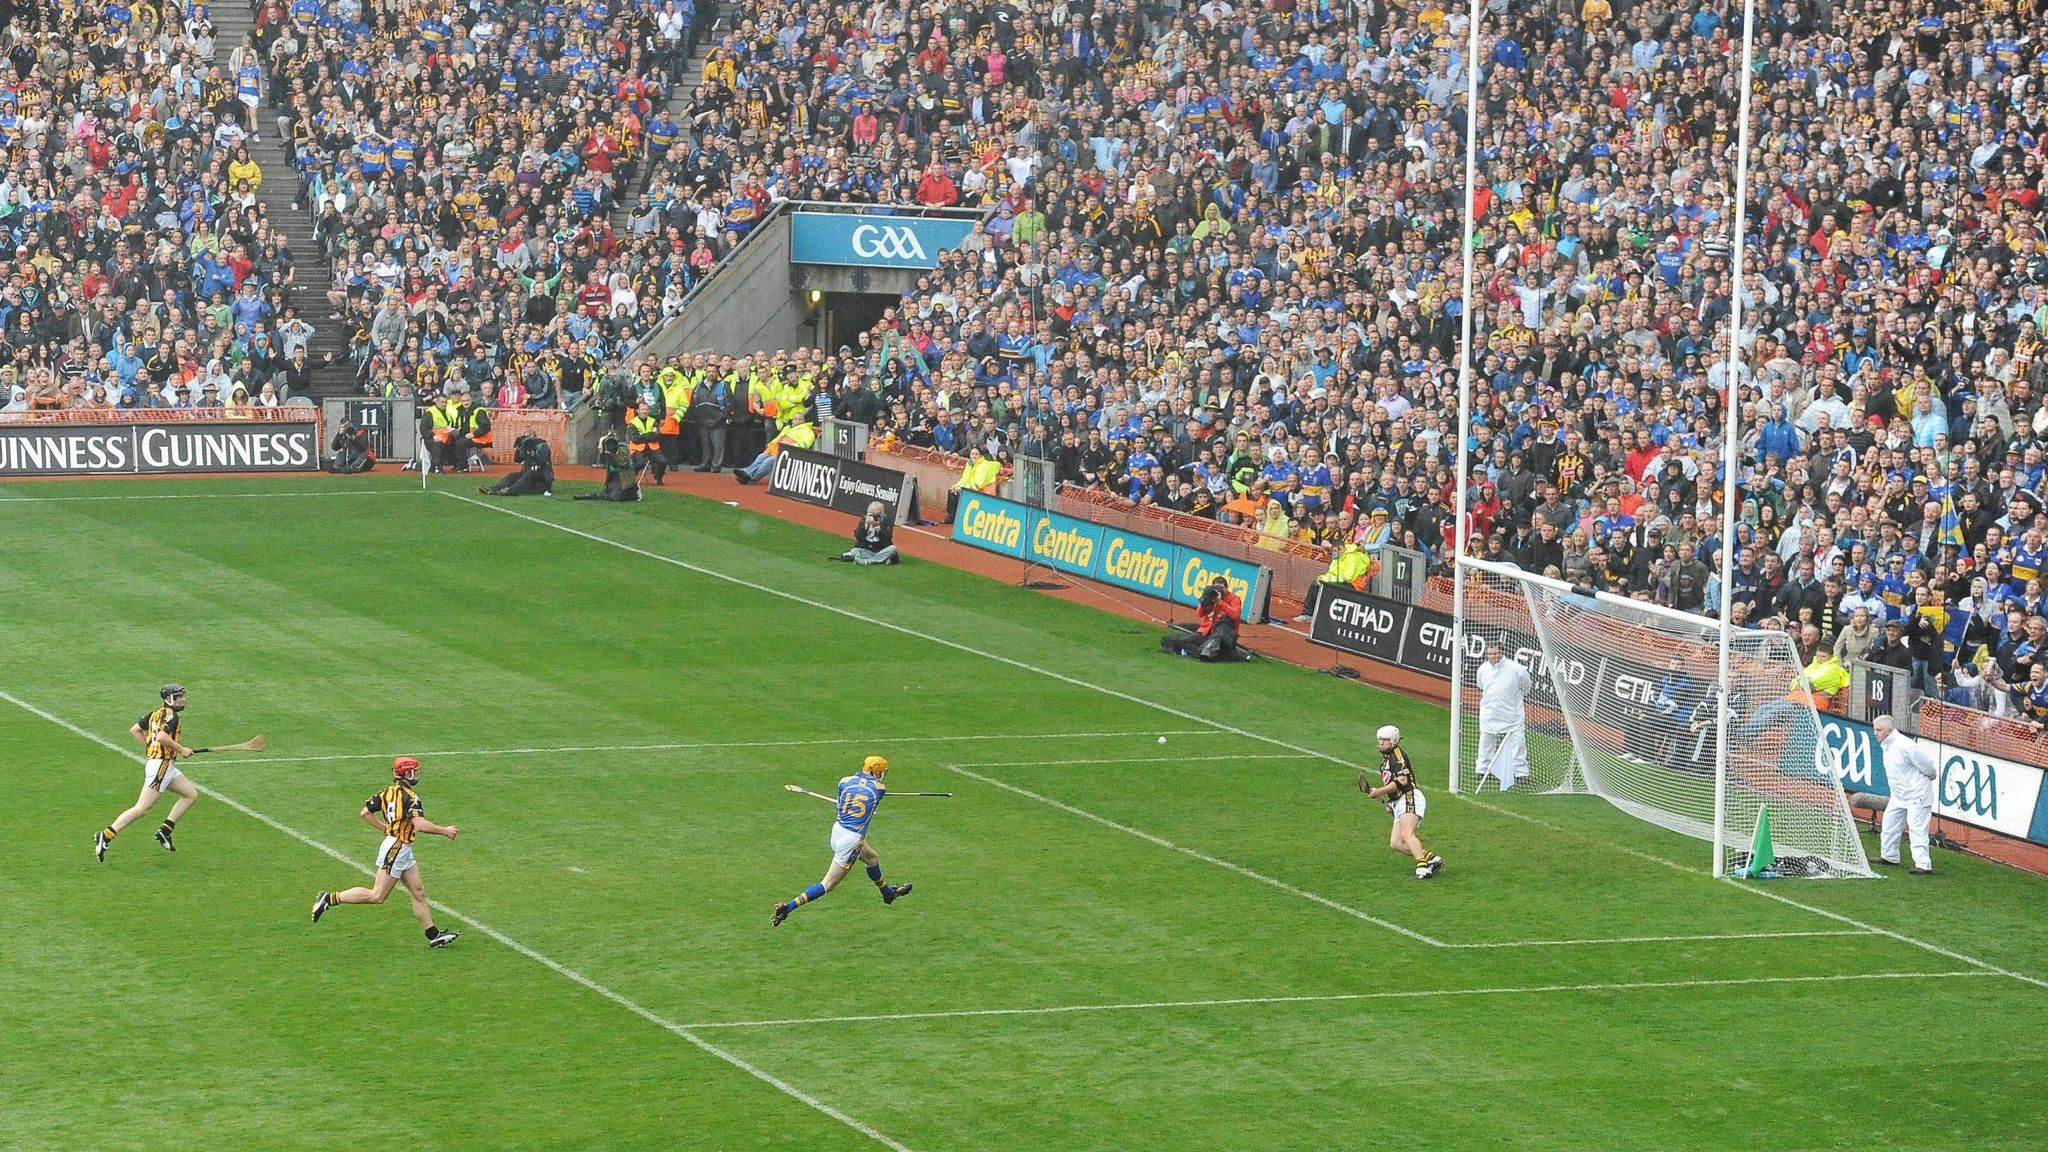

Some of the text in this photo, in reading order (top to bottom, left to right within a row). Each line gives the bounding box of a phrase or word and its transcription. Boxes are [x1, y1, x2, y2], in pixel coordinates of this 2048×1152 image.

[852, 224, 927, 260] GAA
[360, 408, 378, 426] 11
[142, 428, 309, 467] GUINNESS
[838, 429, 848, 445] 15
[774, 450, 835, 500] GUINNESS
[839, 475, 856, 495] Enjoy
[962, 499, 1021, 548] Centra
[1033, 517, 1093, 568] Centra
[1105, 537, 1169, 588] Centra
[1396, 561, 1406, 580] 17
[1329, 598, 1394, 634] ETIHAD
[1871, 679, 1884, 702] 18
[842, 792, 869, 818] 15
[1940, 755, 1997, 820] GAA
